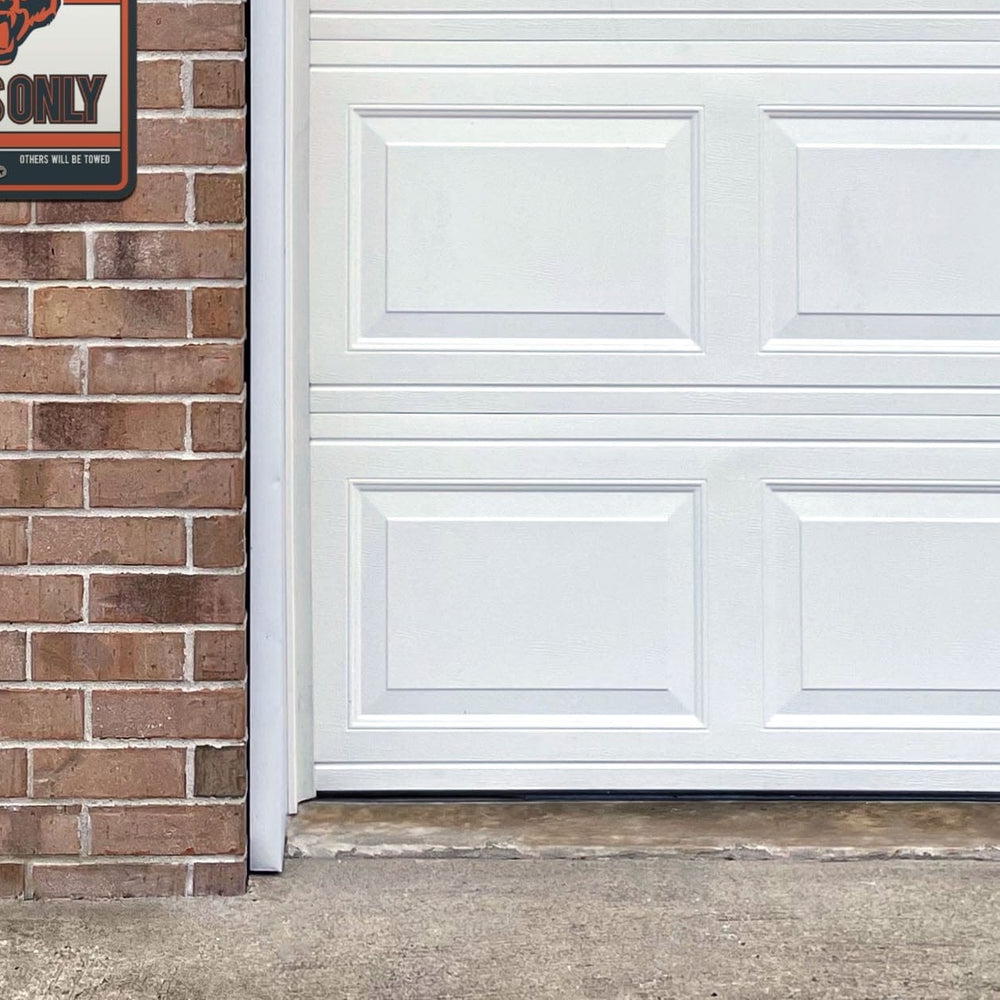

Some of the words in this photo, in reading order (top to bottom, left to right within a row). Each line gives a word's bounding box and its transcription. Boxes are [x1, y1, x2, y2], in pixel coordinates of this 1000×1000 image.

[7, 74, 107, 124] ONLY
[19, 154, 49, 164] OTHERS
[51, 154, 70, 164] WILL
[71, 154, 82, 164] BE
[84, 154, 111, 164] TOWED
